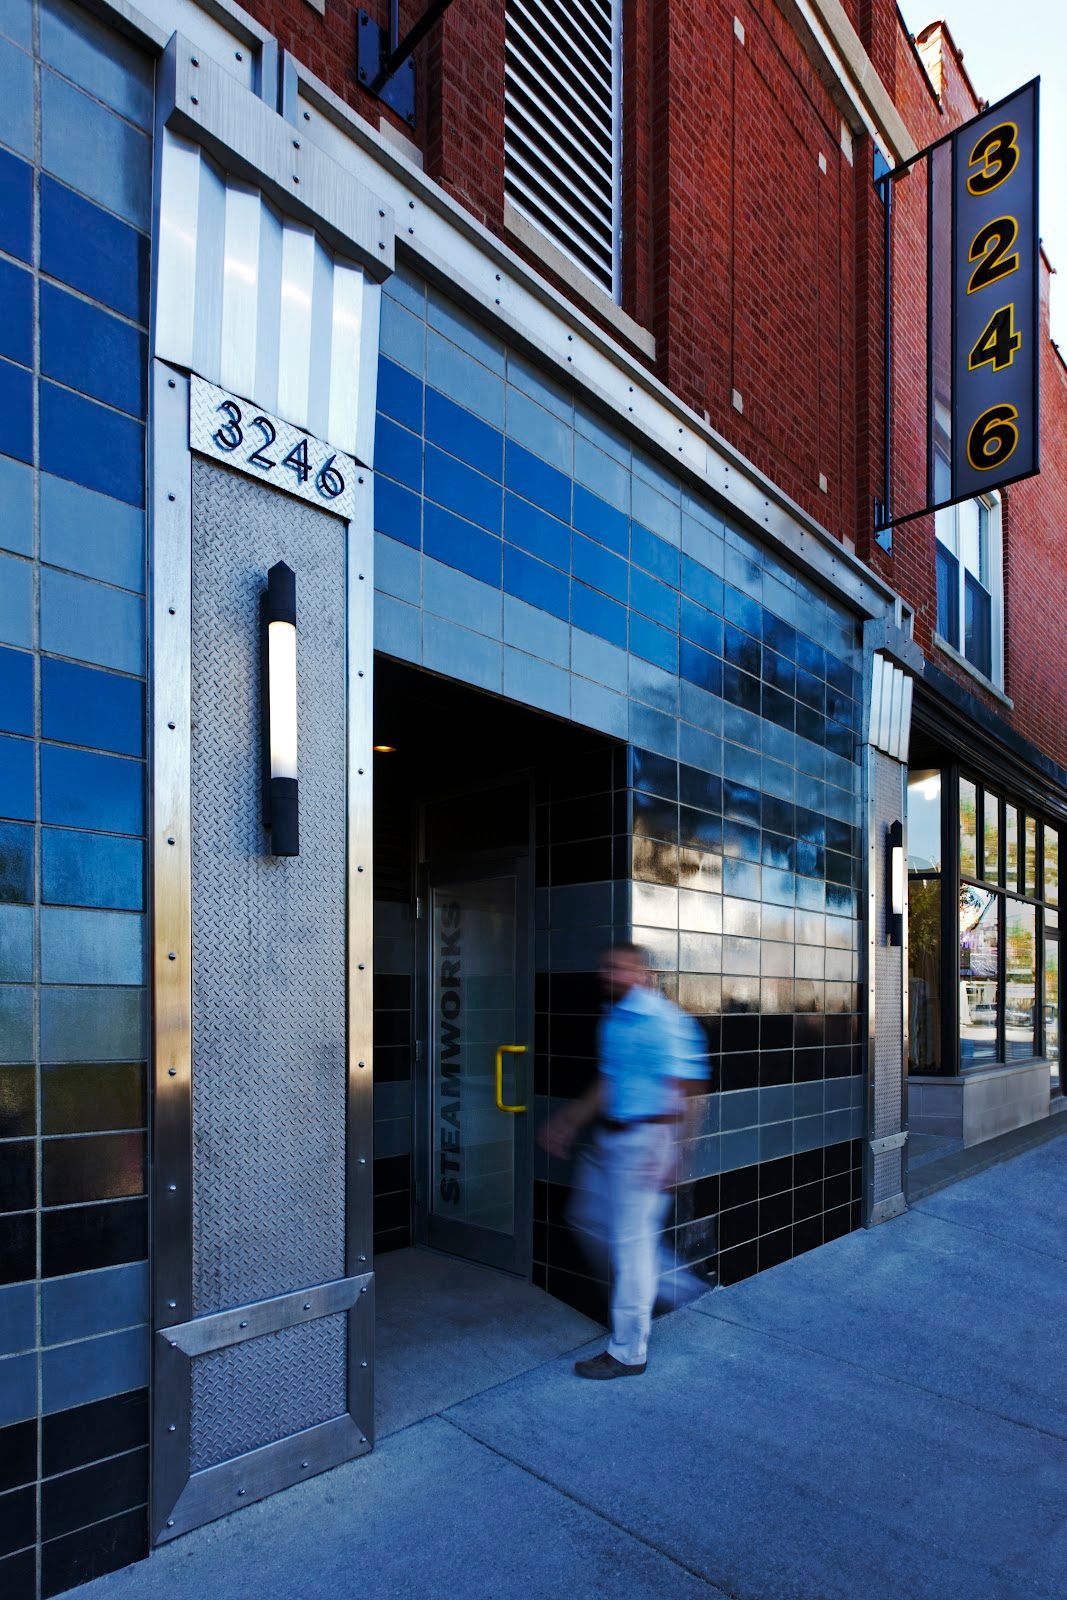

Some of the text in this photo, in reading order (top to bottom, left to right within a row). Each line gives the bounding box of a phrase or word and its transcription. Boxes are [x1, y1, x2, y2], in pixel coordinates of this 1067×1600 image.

[966, 121, 1021, 471] 3246
[213, 400, 344, 498] 3246
[440, 903, 462, 1205] STEAMWORKS
